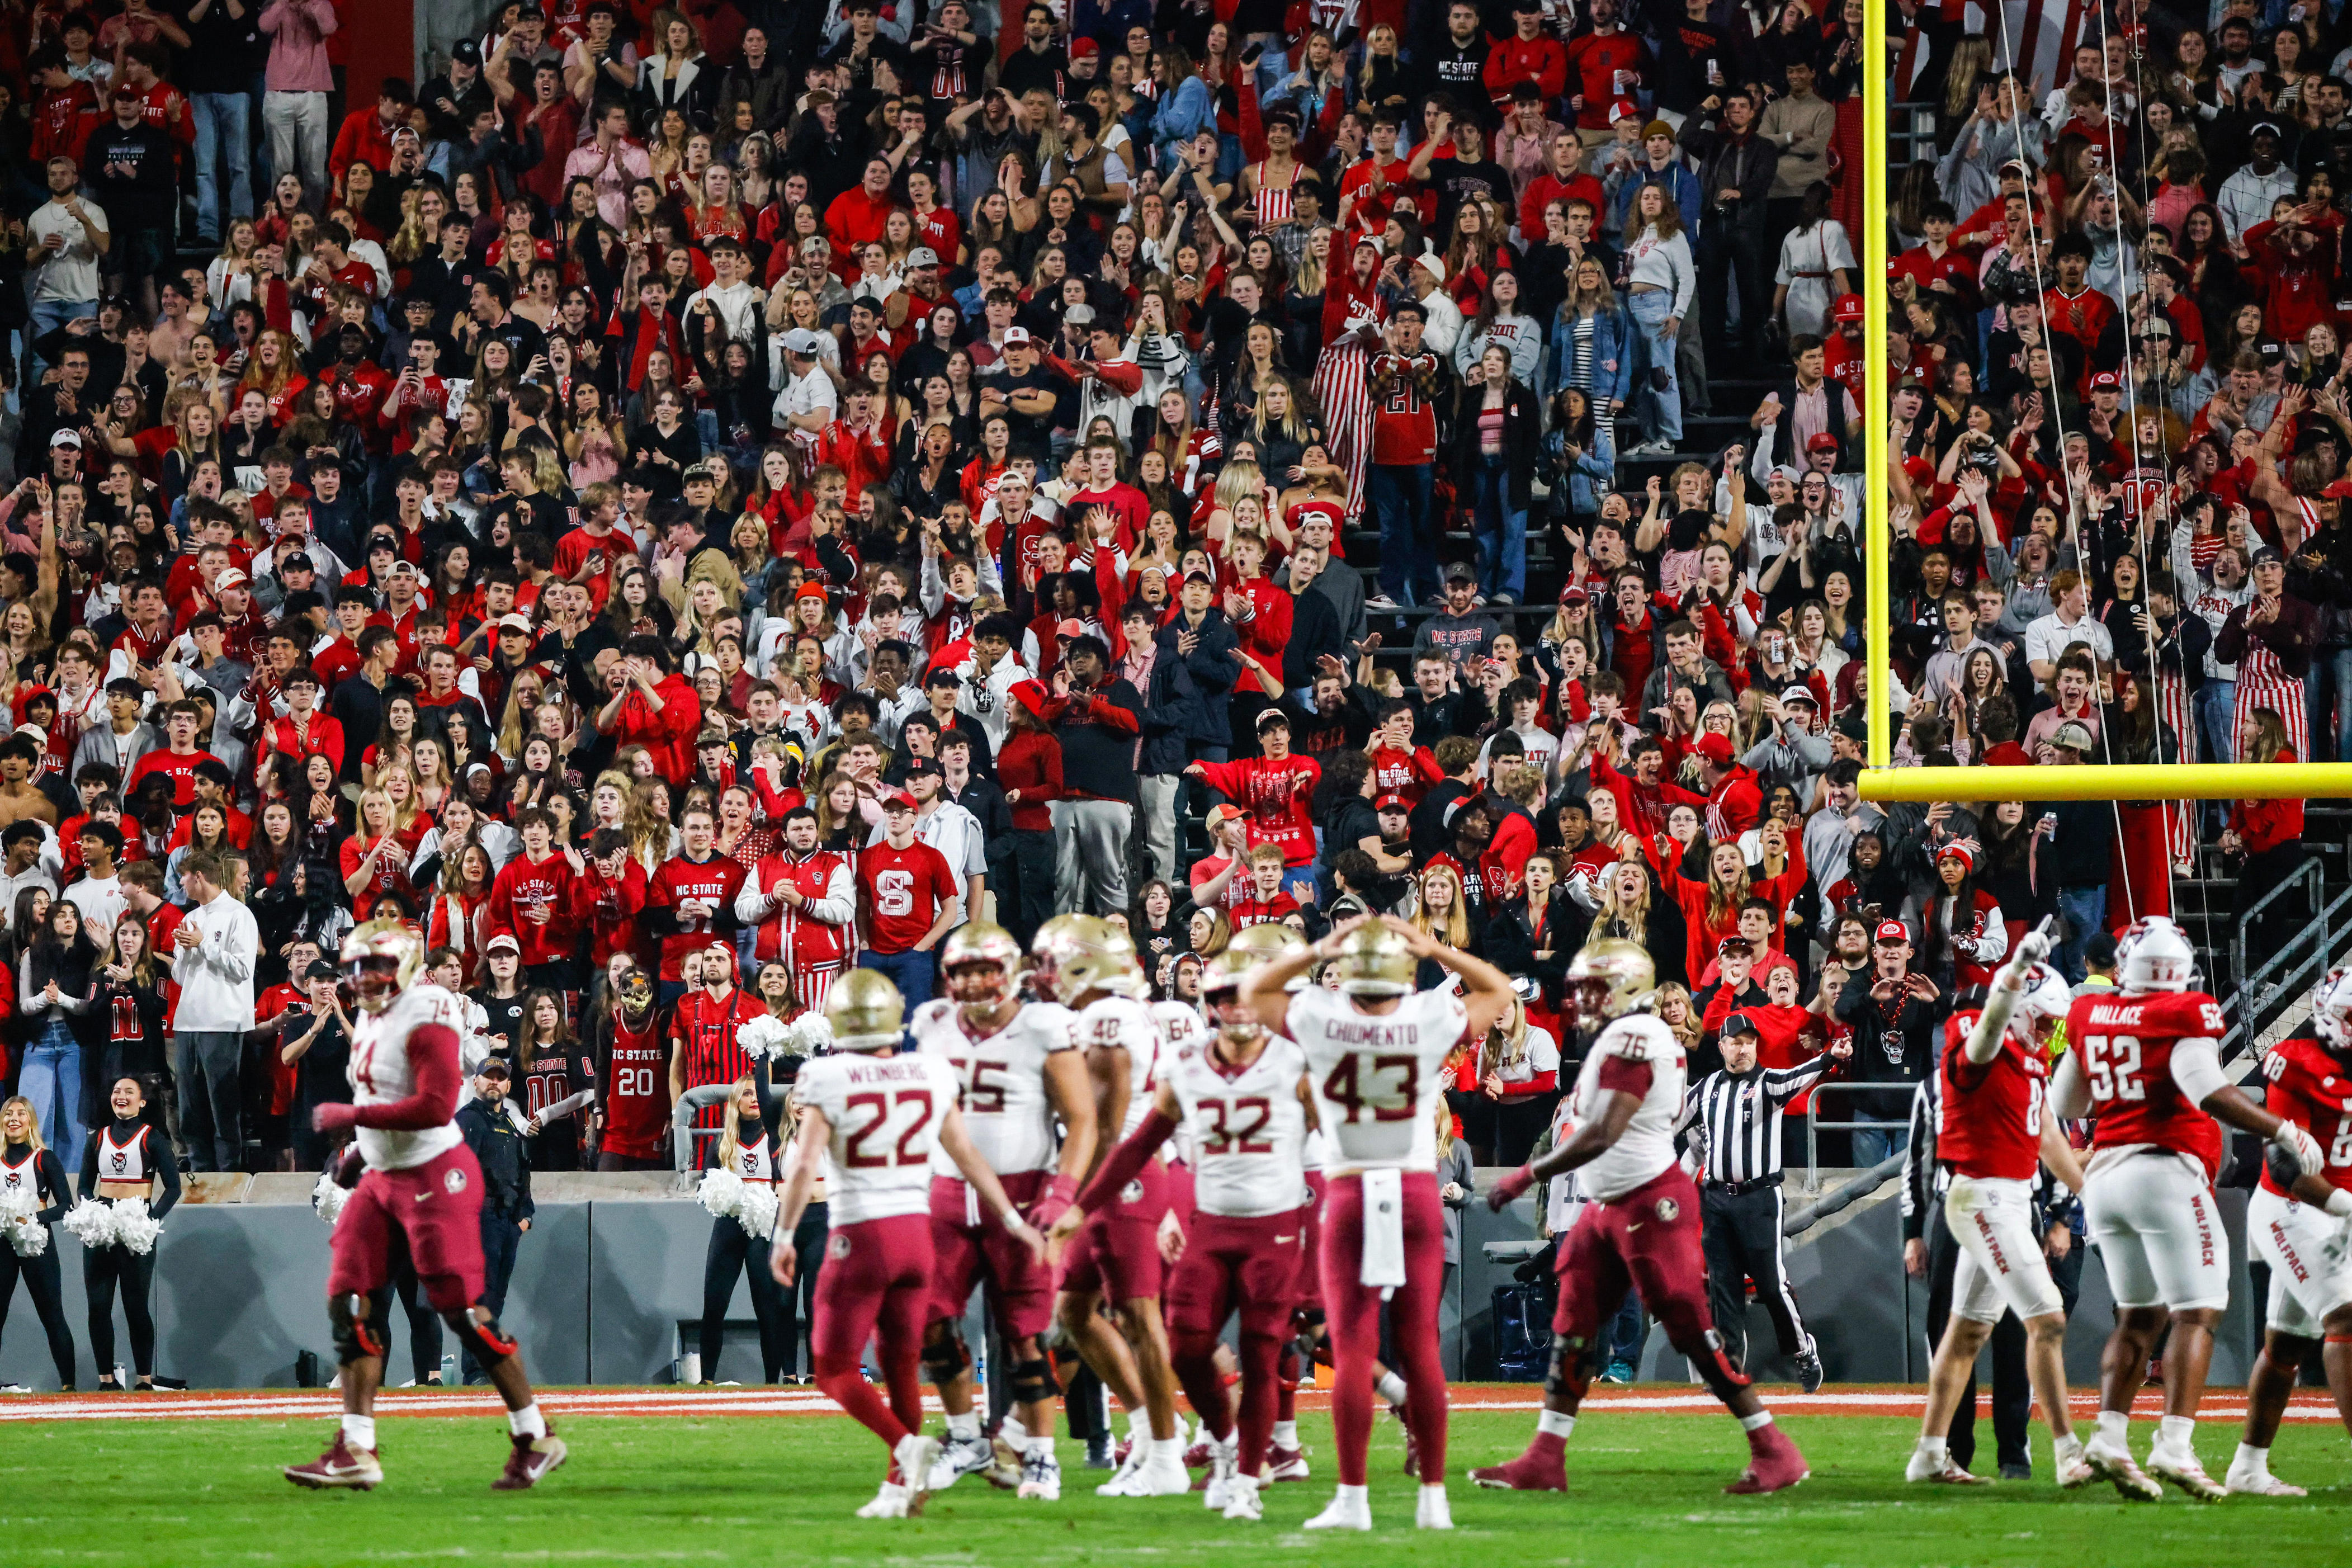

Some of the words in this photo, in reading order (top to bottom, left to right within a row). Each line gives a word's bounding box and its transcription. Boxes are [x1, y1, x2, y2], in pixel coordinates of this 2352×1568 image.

[1438, 61, 1451, 74] NC
[1453, 62, 1479, 75] STATE
[141, 107, 164, 117] TATE
[2091, 144, 2103, 153] ATE
[929, 221, 944, 238] ATE
[1834, 362, 1845, 378] NC
[1849, 359, 1865, 373] STA
[1386, 372, 1420, 414] 21
[259, 517, 276, 527] WO
[1759, 523, 1773, 539] NC
[1432, 630, 1447, 643] NC
[1449, 628, 1482, 643] STATE
[1087, 693, 1109, 704] ATE
[176, 767, 194, 777] STA
[563, 769, 583, 788] TAT
[1378, 769, 1390, 780] NC
[1390, 767, 1410, 780] STATE
[516, 884, 527, 894] NC
[529, 879, 555, 893] STATE
[676, 885, 689, 896] NC
[692, 884, 723, 896] STATE
[493, 937, 513, 946] WOLFPACK
[300, 1002, 313, 1012] STA
[2089, 1004, 2145, 1026] WALLACE
[2199, 1002, 2225, 1031] 52
[1169, 1016, 1194, 1041] 64
[1325, 1018, 1418, 1046] CHIUMENTO
[484, 1057, 506, 1068] POLICE
[625, 1049, 664, 1061] STATE
[1501, 1052, 1526, 1068] STTE
[536, 1057, 566, 1072] STATE
[2084, 1034, 2147, 1102] 52
[848, 1062, 928, 1085] WEINBERG
[618, 1067, 654, 1097] 20
[948, 1060, 1009, 1113] 5
[1322, 1051, 1419, 1123] 43
[526, 1073, 570, 1122] 00
[1711, 1091, 1719, 1099] S
[1743, 1110, 1751, 1122] F
[846, 1089, 933, 1169] 22
[1196, 1096, 1274, 1156] 32
[2192, 1194, 2216, 1267] WOLFPACK
[1973, 1208, 2011, 1277] WOLFPACK
[2269, 1218, 2311, 1284] WOLFPACK
